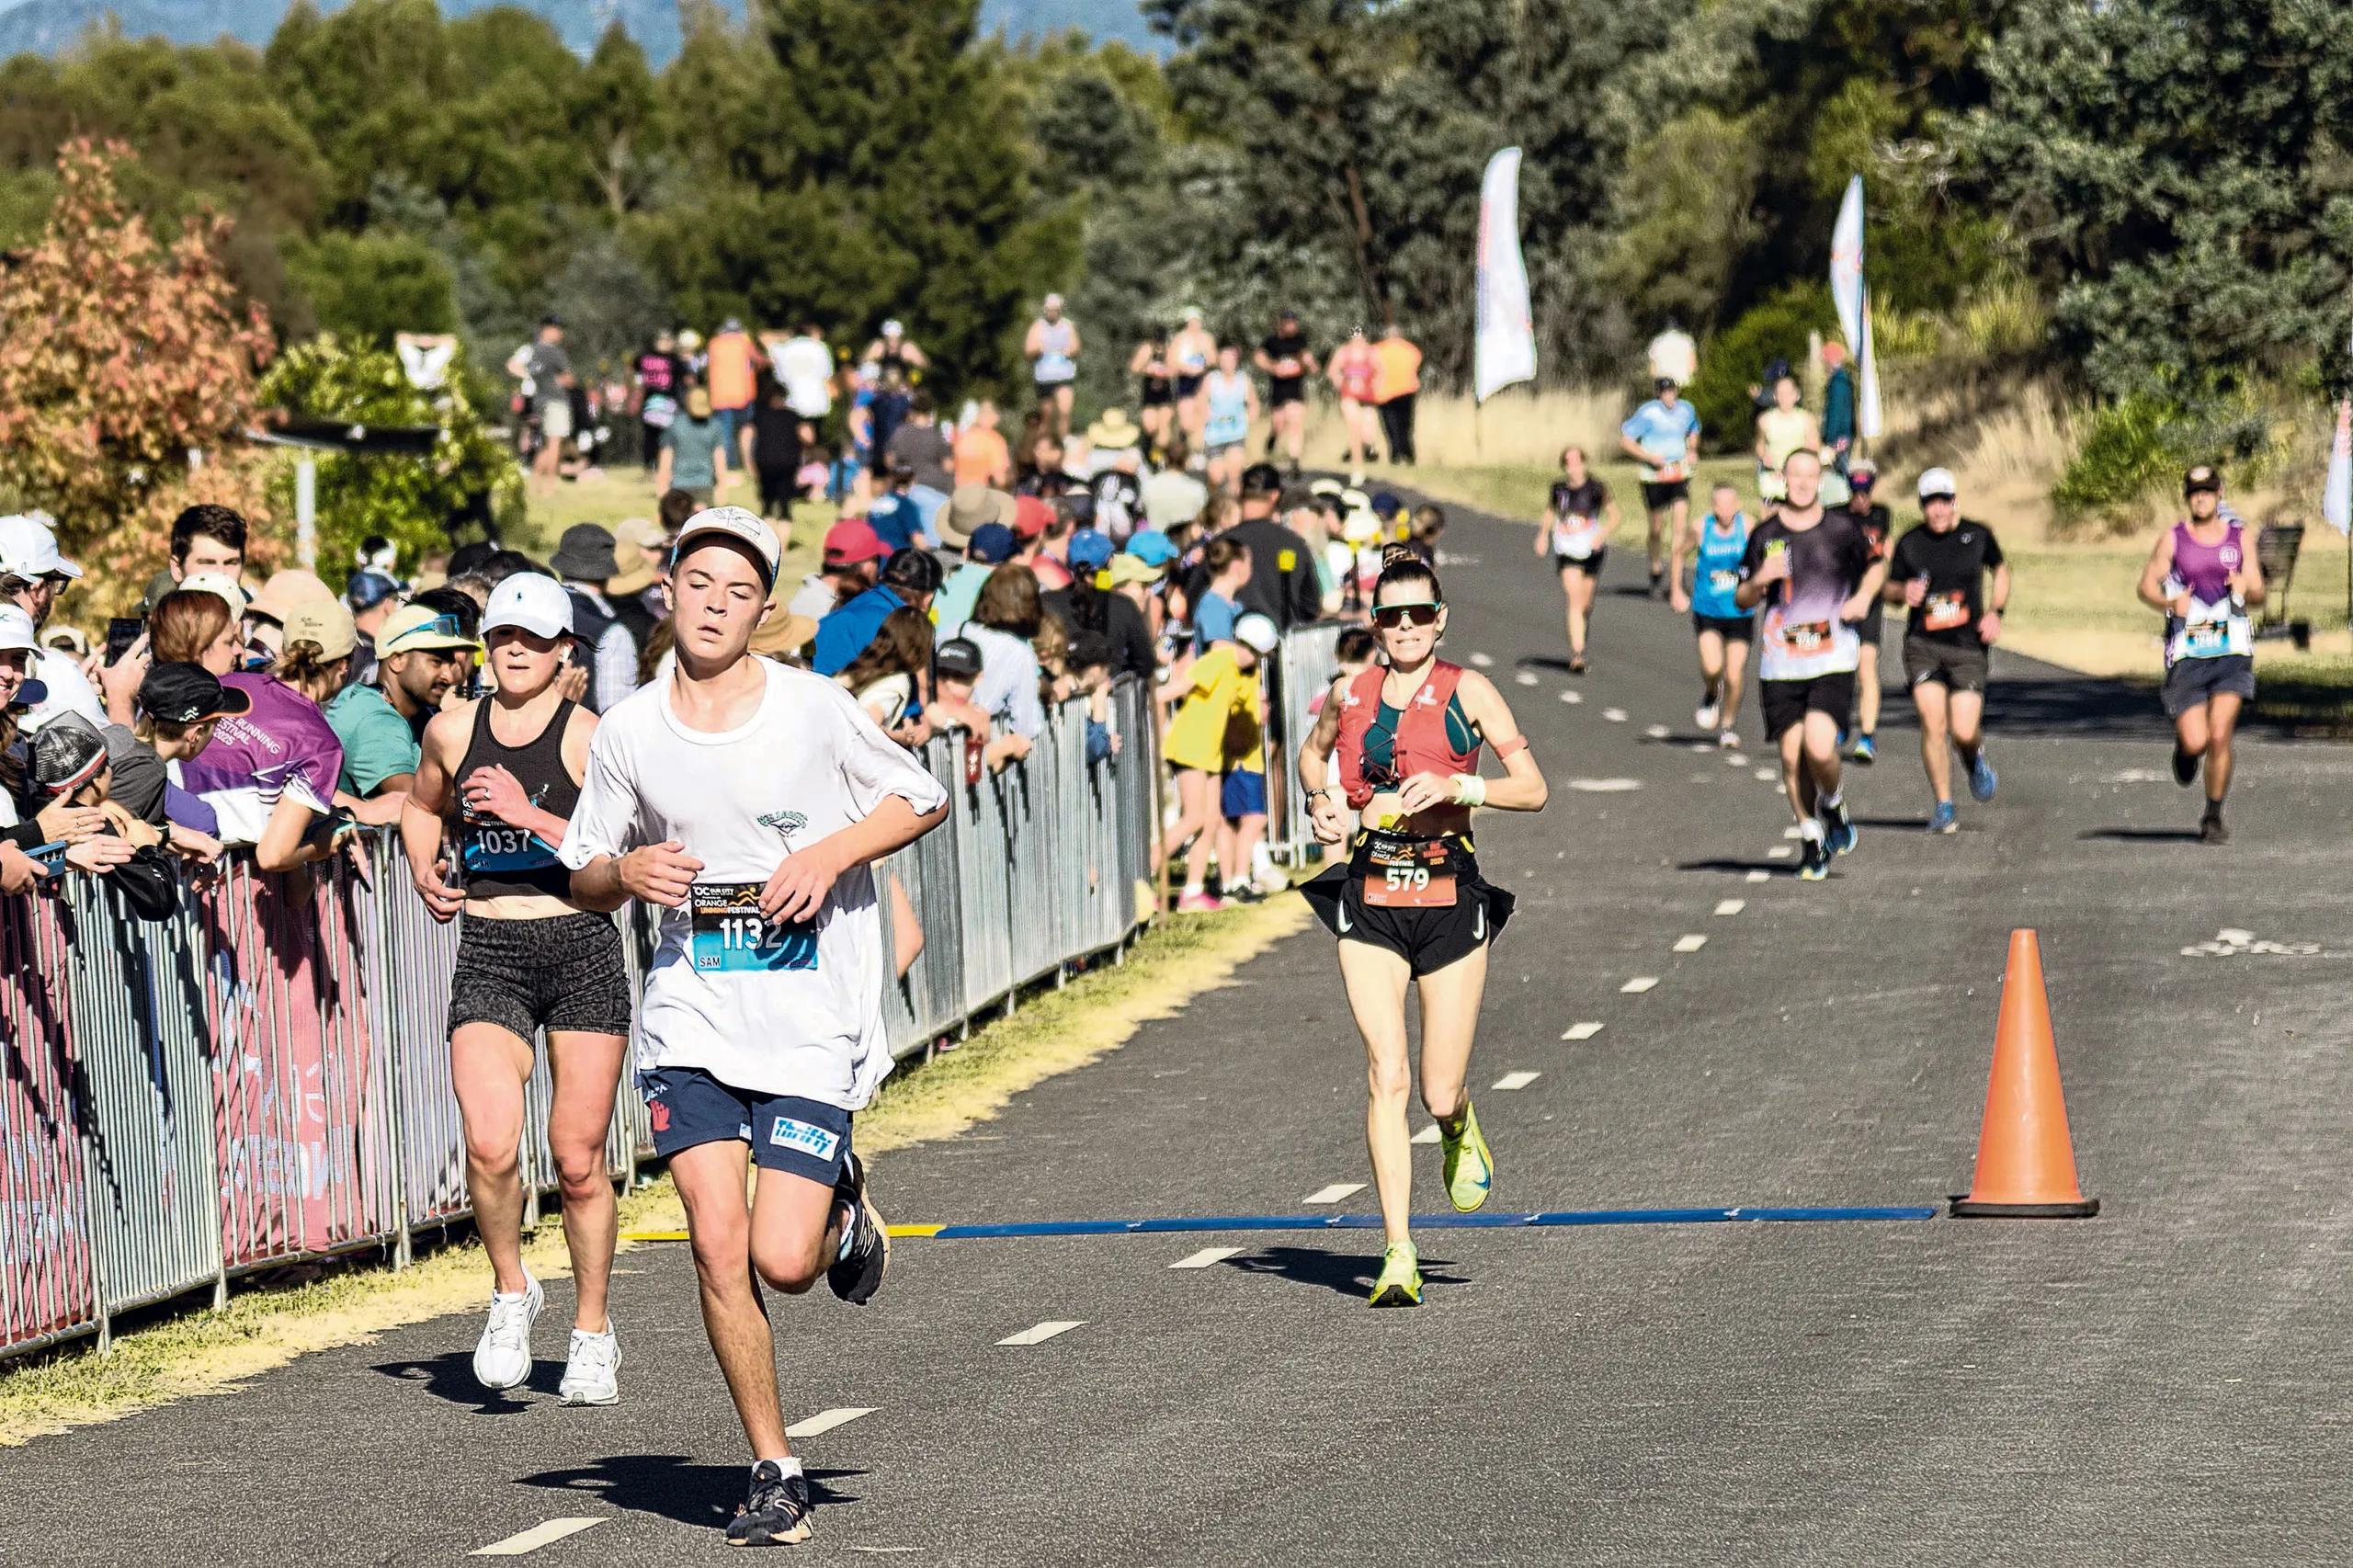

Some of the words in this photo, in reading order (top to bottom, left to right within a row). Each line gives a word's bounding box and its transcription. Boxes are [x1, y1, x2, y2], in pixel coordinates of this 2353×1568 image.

[213, 727, 235, 745] 2025
[217, 717, 249, 745] STIVAL
[235, 718, 280, 754] RUNNING
[476, 828, 531, 855] 1037
[1386, 867, 1429, 892] 579
[694, 898, 728, 907] ORANGE
[720, 918, 782, 949] 1132
[699, 956, 721, 968] SAM
